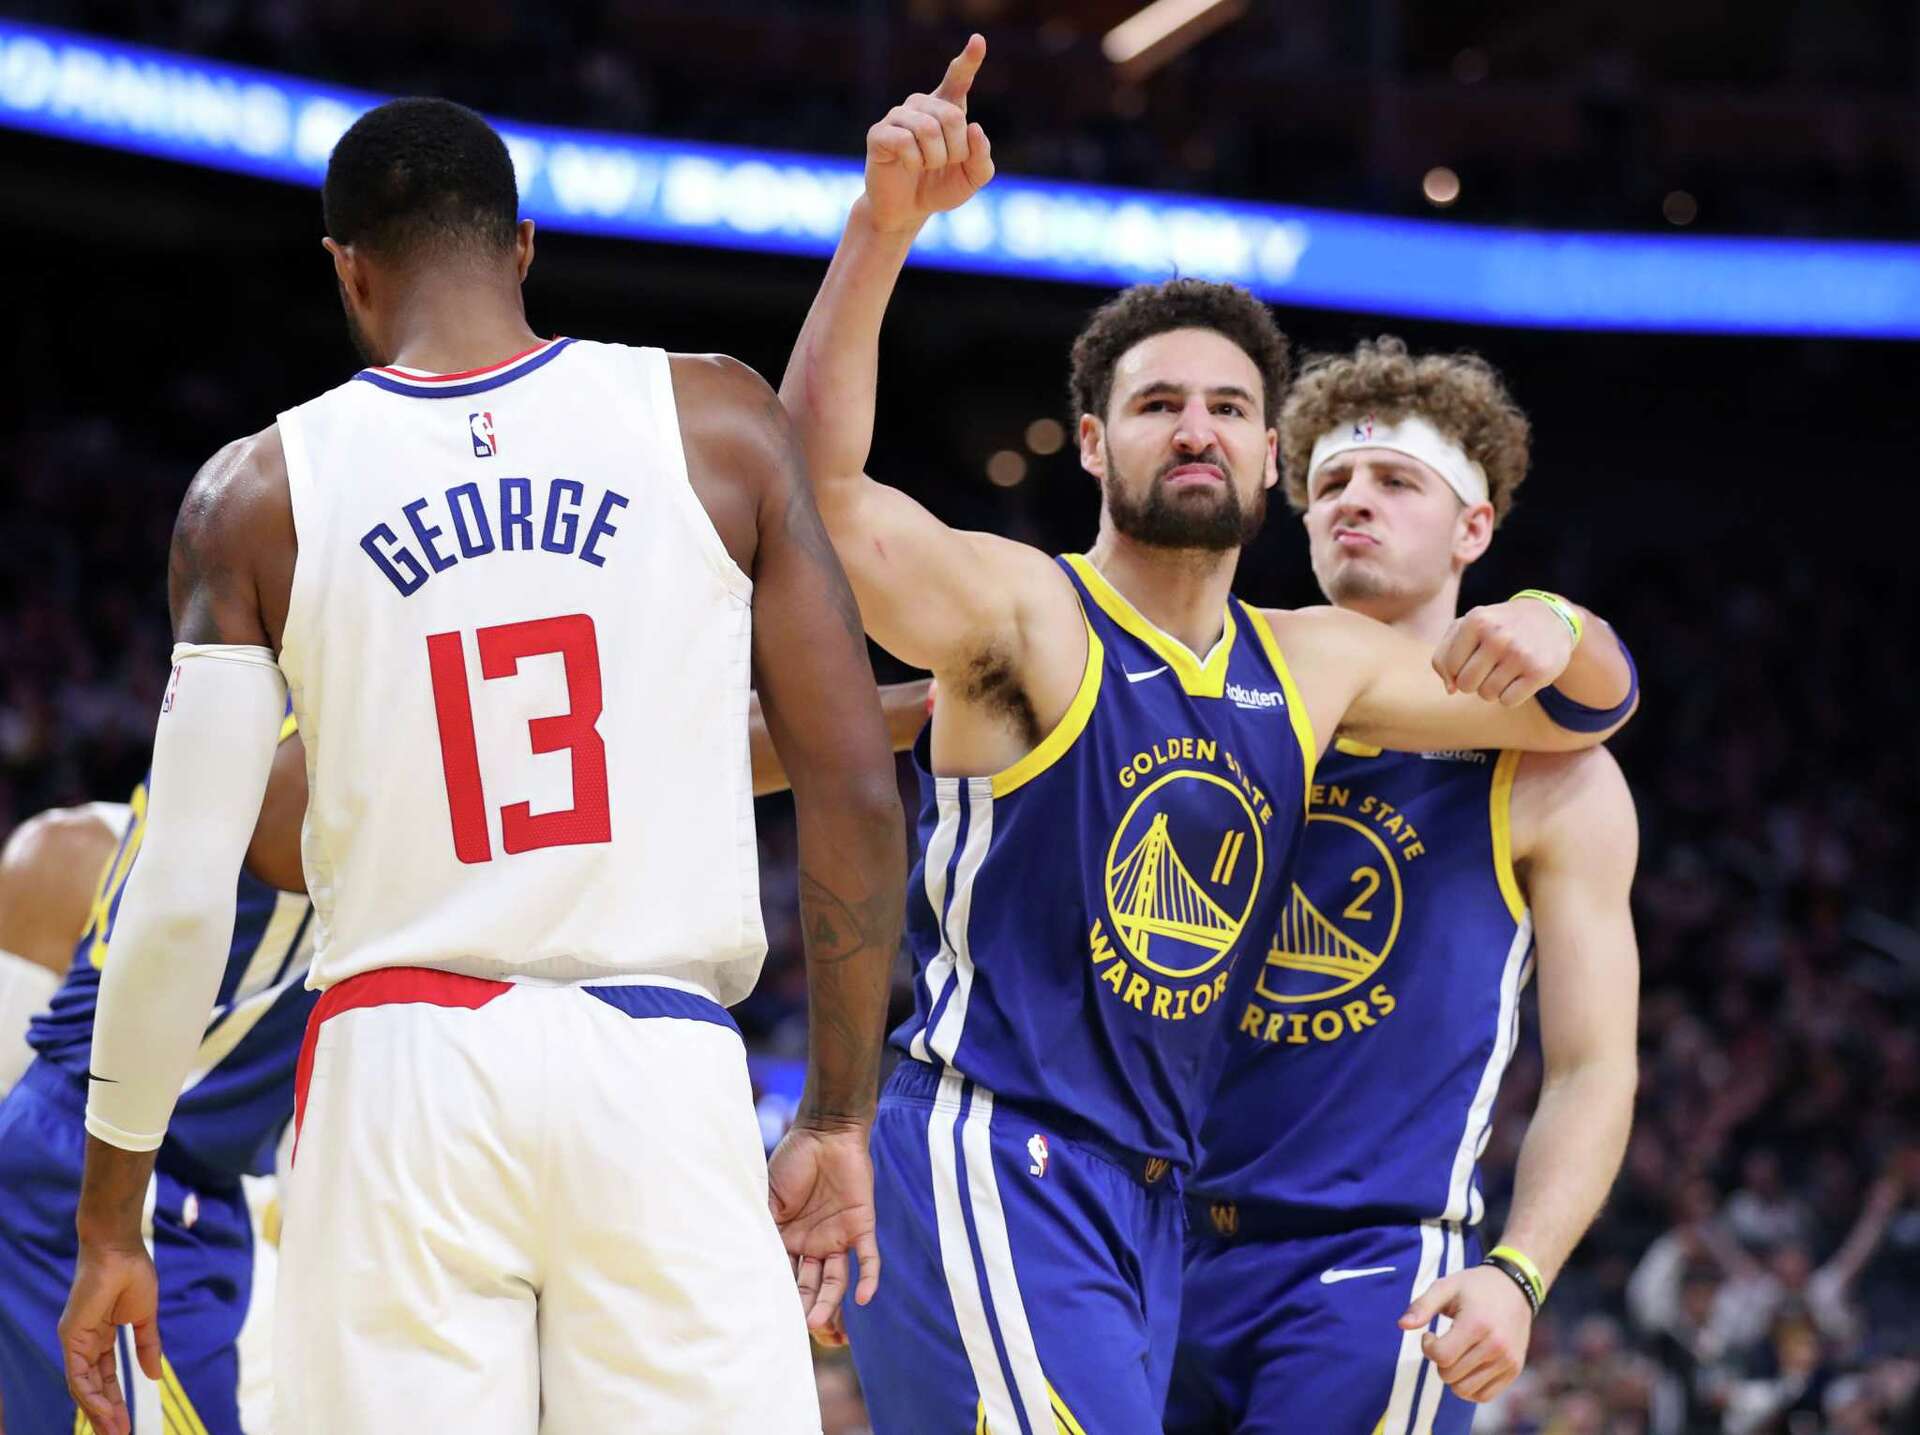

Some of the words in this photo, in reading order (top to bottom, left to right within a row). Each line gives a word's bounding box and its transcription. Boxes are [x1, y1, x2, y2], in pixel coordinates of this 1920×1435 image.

[360, 477, 629, 598] GEORGE
[426, 613, 612, 864] 13
[1118, 737, 1216, 788] GOLDEN
[1225, 751, 1273, 826] STATE
[1210, 829, 1245, 886] 11
[1358, 795, 1426, 861] STATE
[1342, 866, 1381, 921] 2
[1089, 917, 1236, 1020] WARRIOR
[1239, 984, 1397, 1044] RRIORS
